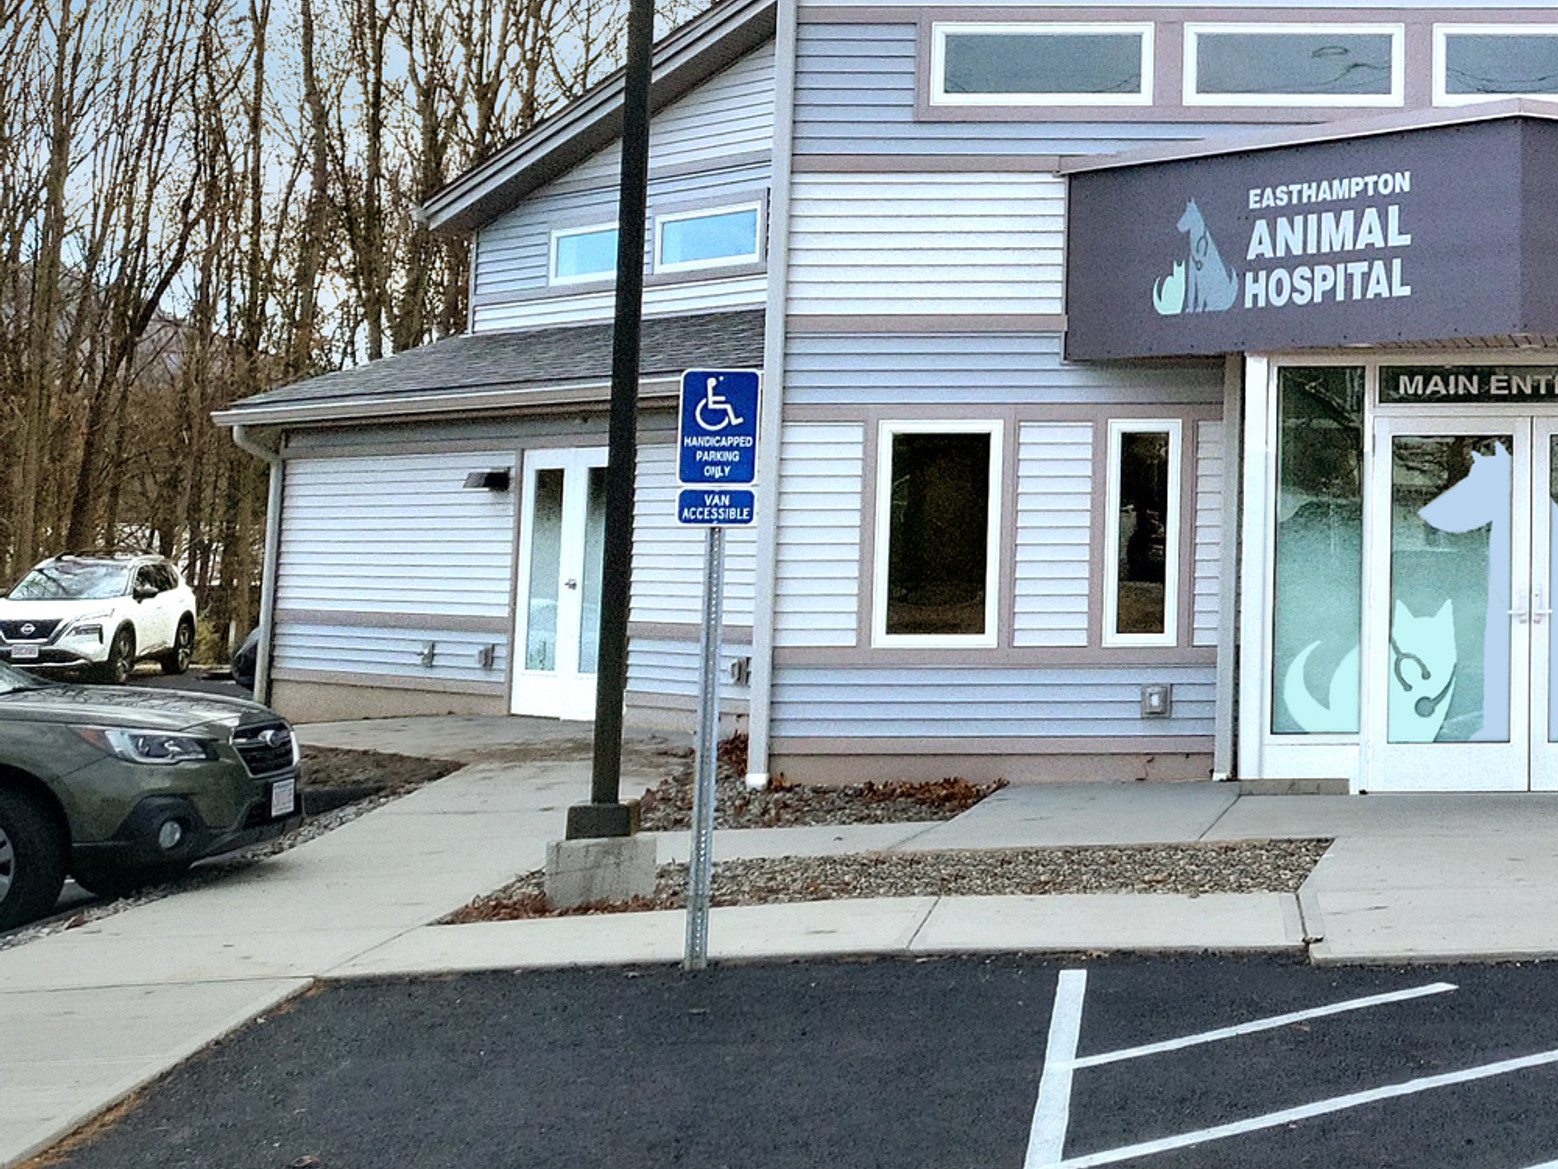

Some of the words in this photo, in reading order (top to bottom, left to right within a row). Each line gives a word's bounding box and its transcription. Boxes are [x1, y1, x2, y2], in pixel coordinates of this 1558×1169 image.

[1249, 172, 1411, 209] EASTHAMPTON
[1247, 204, 1412, 259] ANIMAL
[1244, 258, 1411, 308] HOSPITAL
[1398, 374, 1480, 395] MAIN
[683, 436, 753, 447] HANDICAPPED
[696, 451, 740, 462] PARKING
[704, 465, 731, 477] ONLY
[704, 494, 730, 506] VAN
[682, 508, 751, 519] ACCESSIBLE
